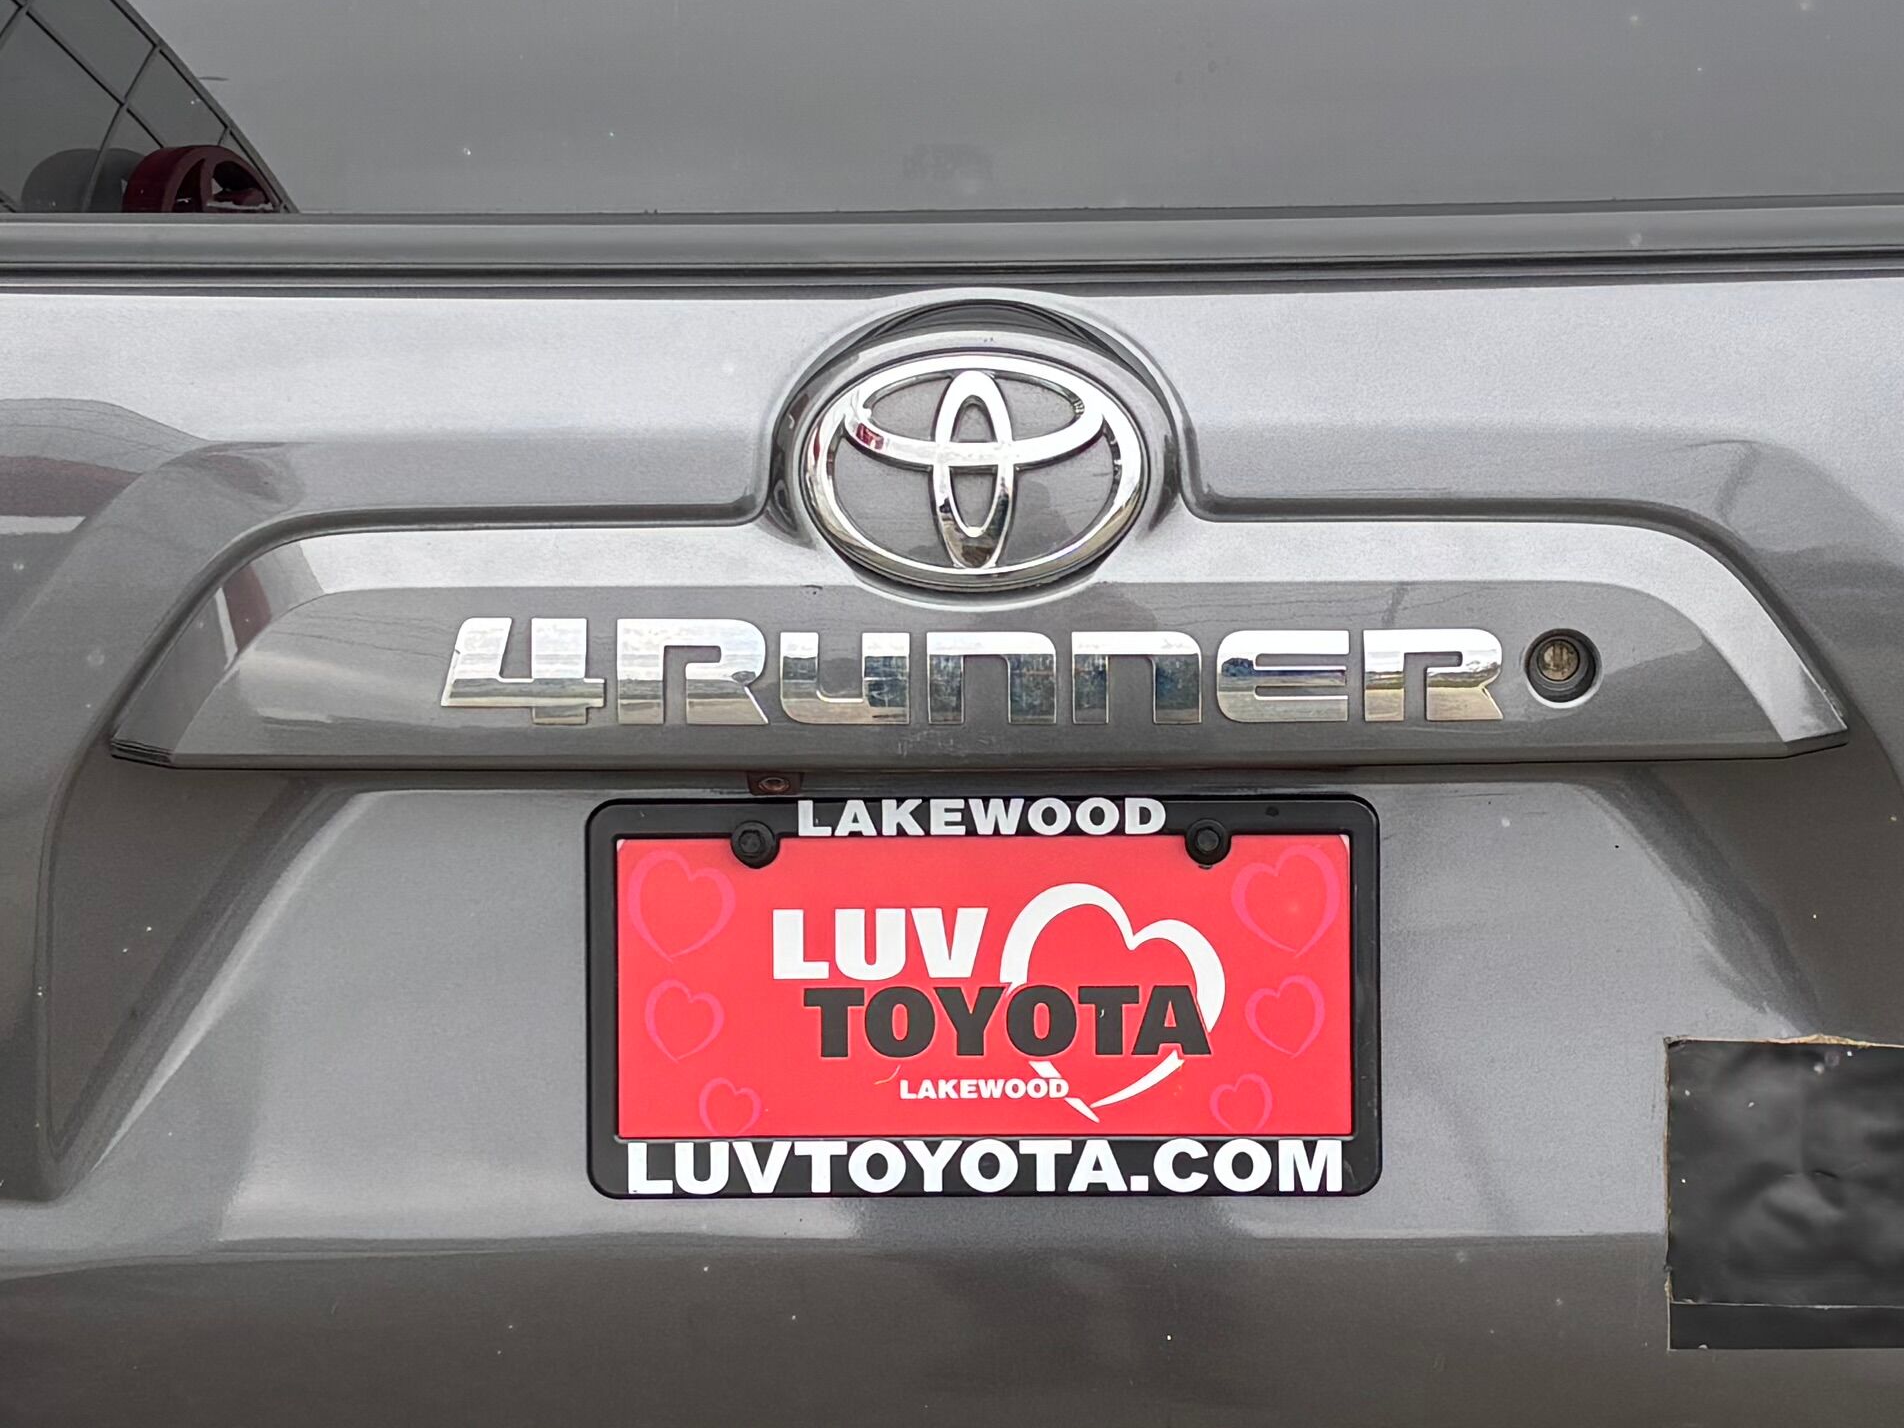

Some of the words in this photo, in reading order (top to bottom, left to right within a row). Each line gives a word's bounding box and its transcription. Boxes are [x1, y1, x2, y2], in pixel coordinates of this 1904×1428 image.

[796, 797, 1167, 837] LAKEWOOD
[771, 906, 989, 980] LUV
[803, 984, 1212, 1059] TOYOTA
[899, 1076, 1070, 1100] LAKEWOOD
[626, 1138, 1344, 1195] LUVTOYOTA.COM
